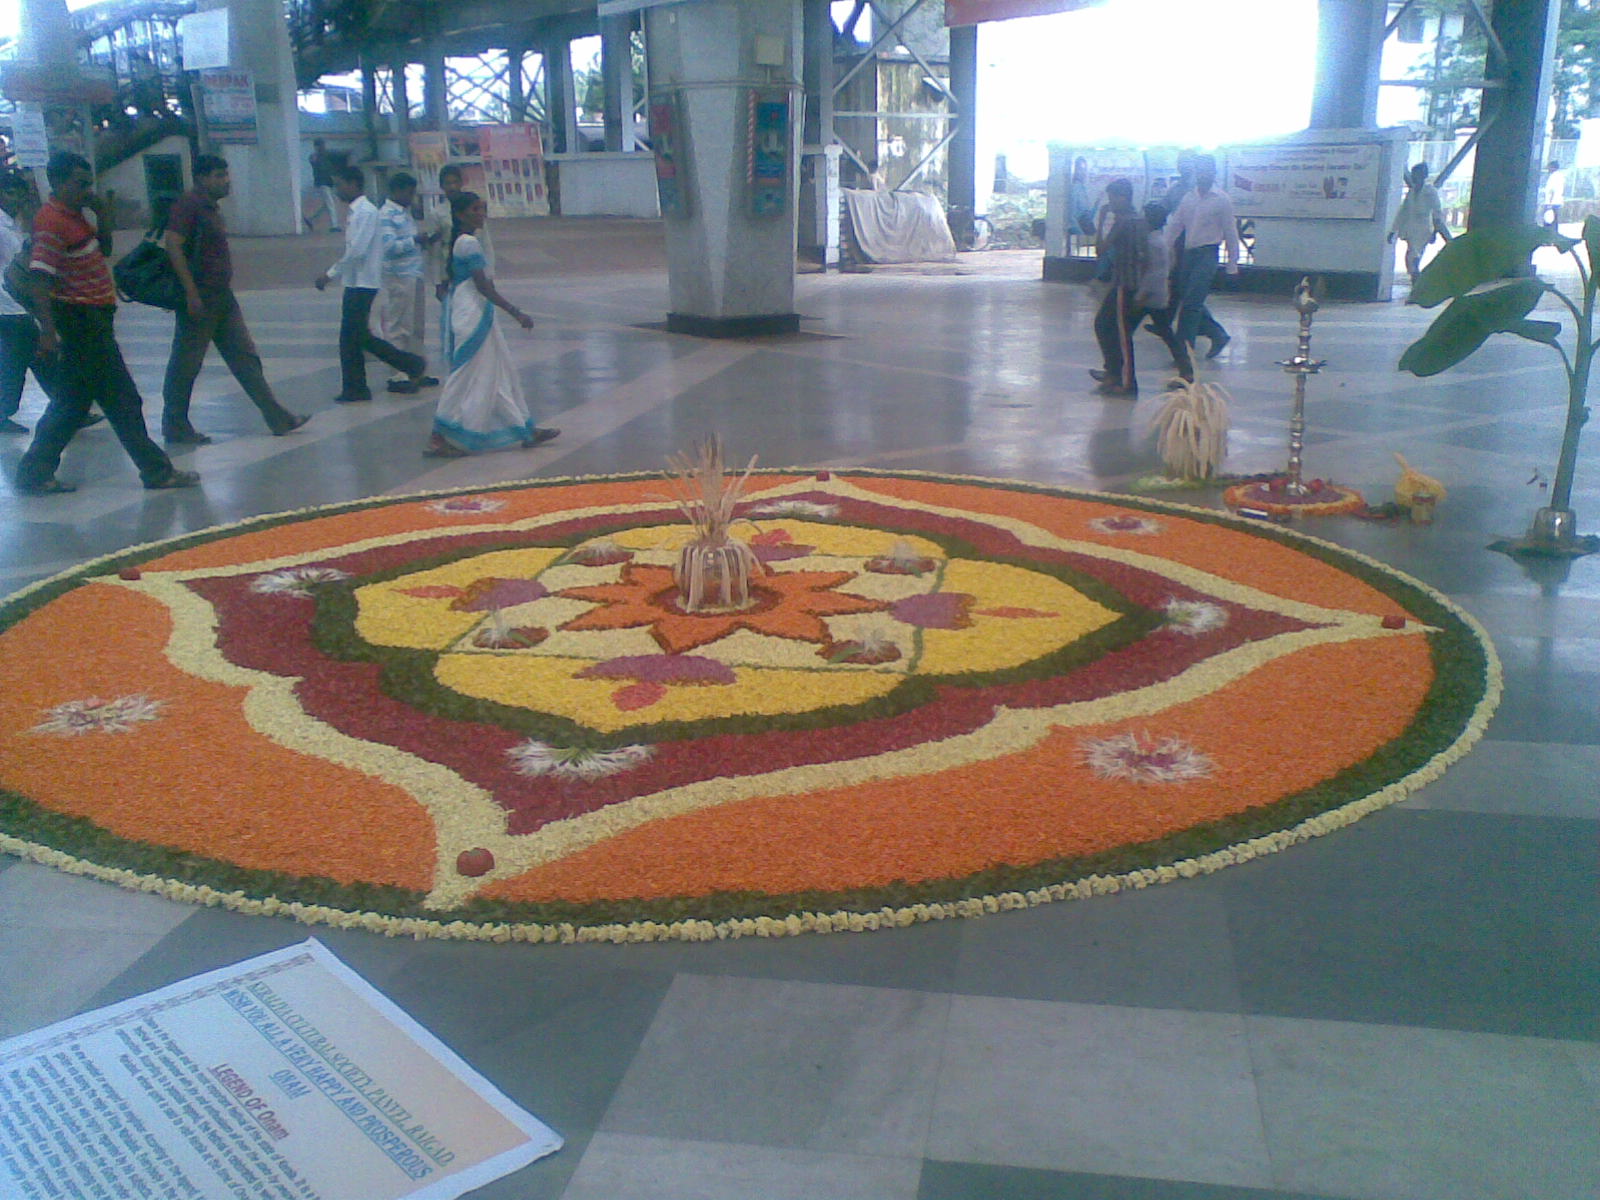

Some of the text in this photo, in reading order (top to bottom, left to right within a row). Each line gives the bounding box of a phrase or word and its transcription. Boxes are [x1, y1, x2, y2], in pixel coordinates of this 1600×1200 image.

[285, 1014, 337, 1054] CULTURAL
[212, 1063, 292, 1138] LEGEND OF Onam
[225, 990, 433, 1177] WISH YOU ALL A VERY HAPPY AND PROSPEROUS
[273, 1069, 310, 1096] ONAM
